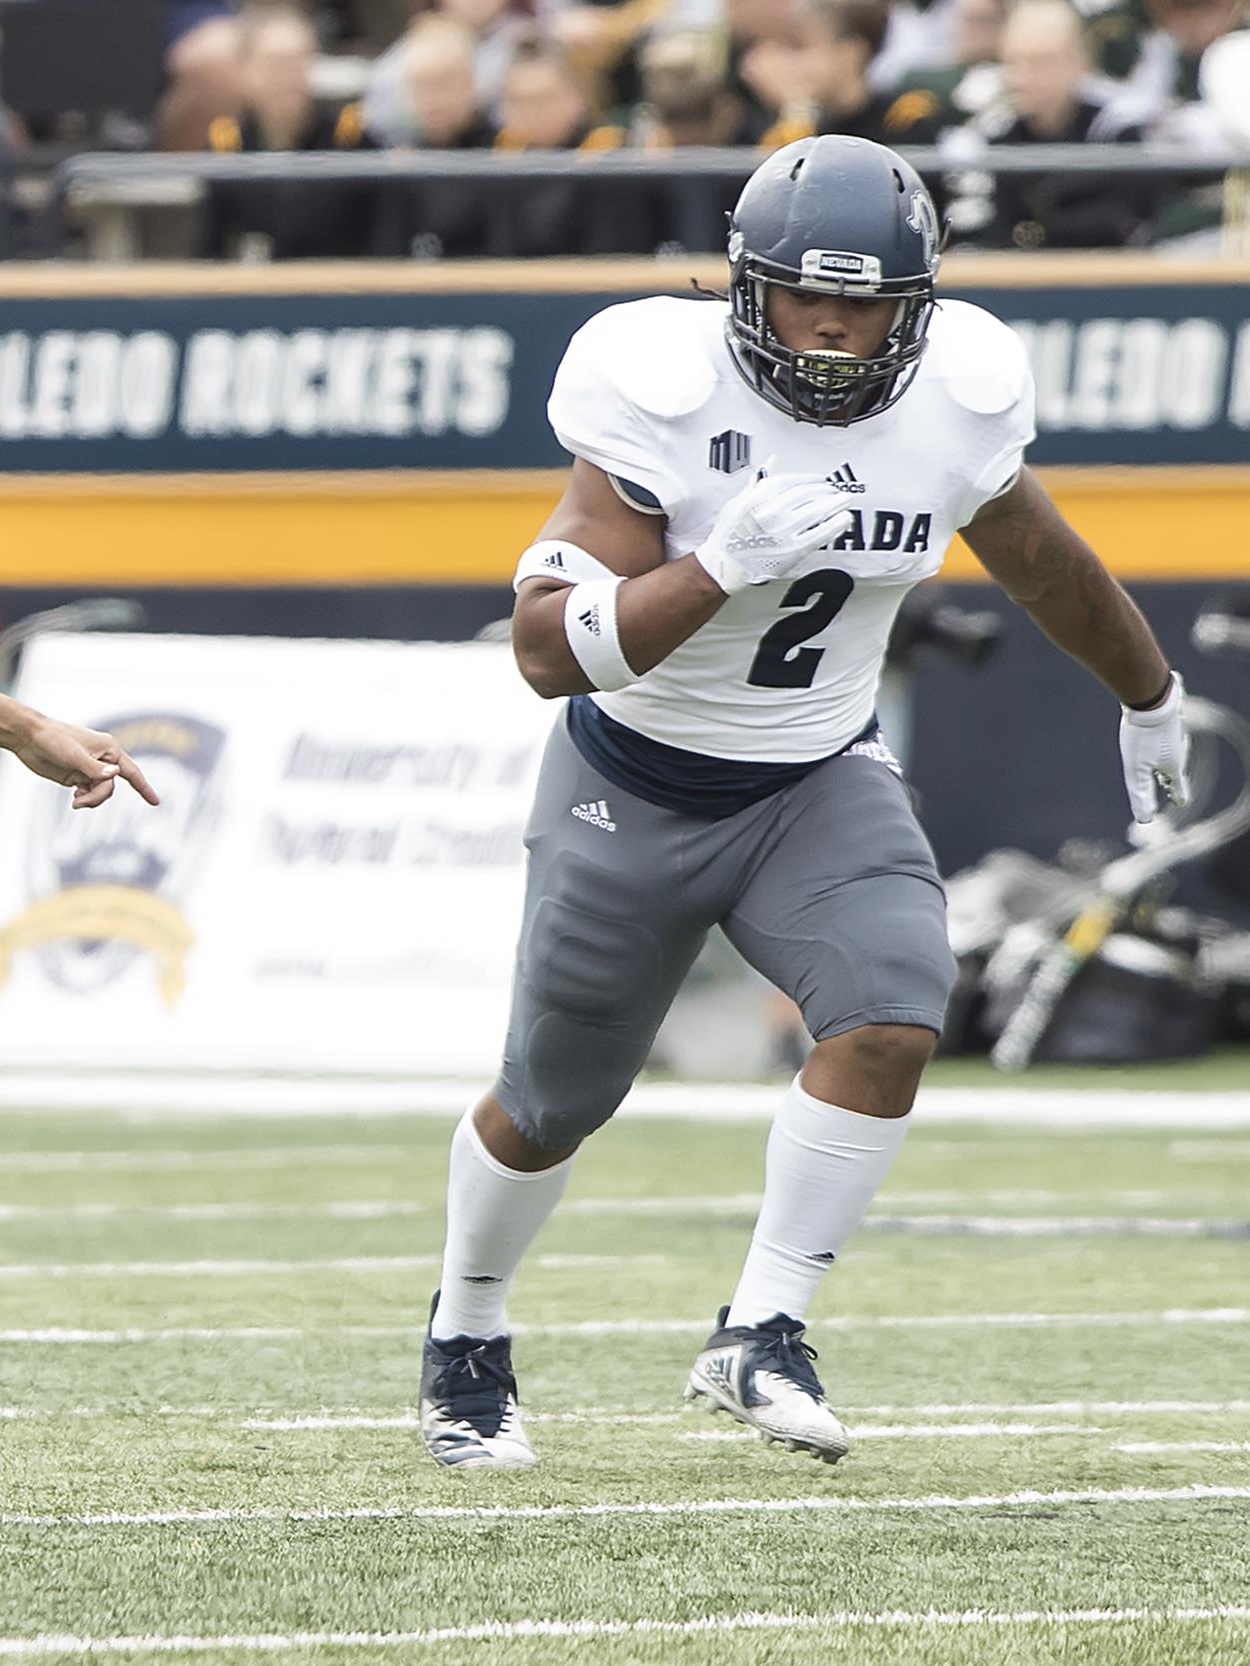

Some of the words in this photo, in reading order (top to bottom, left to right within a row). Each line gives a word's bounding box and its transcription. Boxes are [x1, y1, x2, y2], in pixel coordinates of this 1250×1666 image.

[820, 256, 862, 271] NEVADA
[179, 326, 514, 439] ROCKETS
[1009, 318, 1226, 432] LEDO
[818, 509, 932, 552] ADA
[747, 568, 855, 688] 2
[571, 806, 616, 832] adidas
